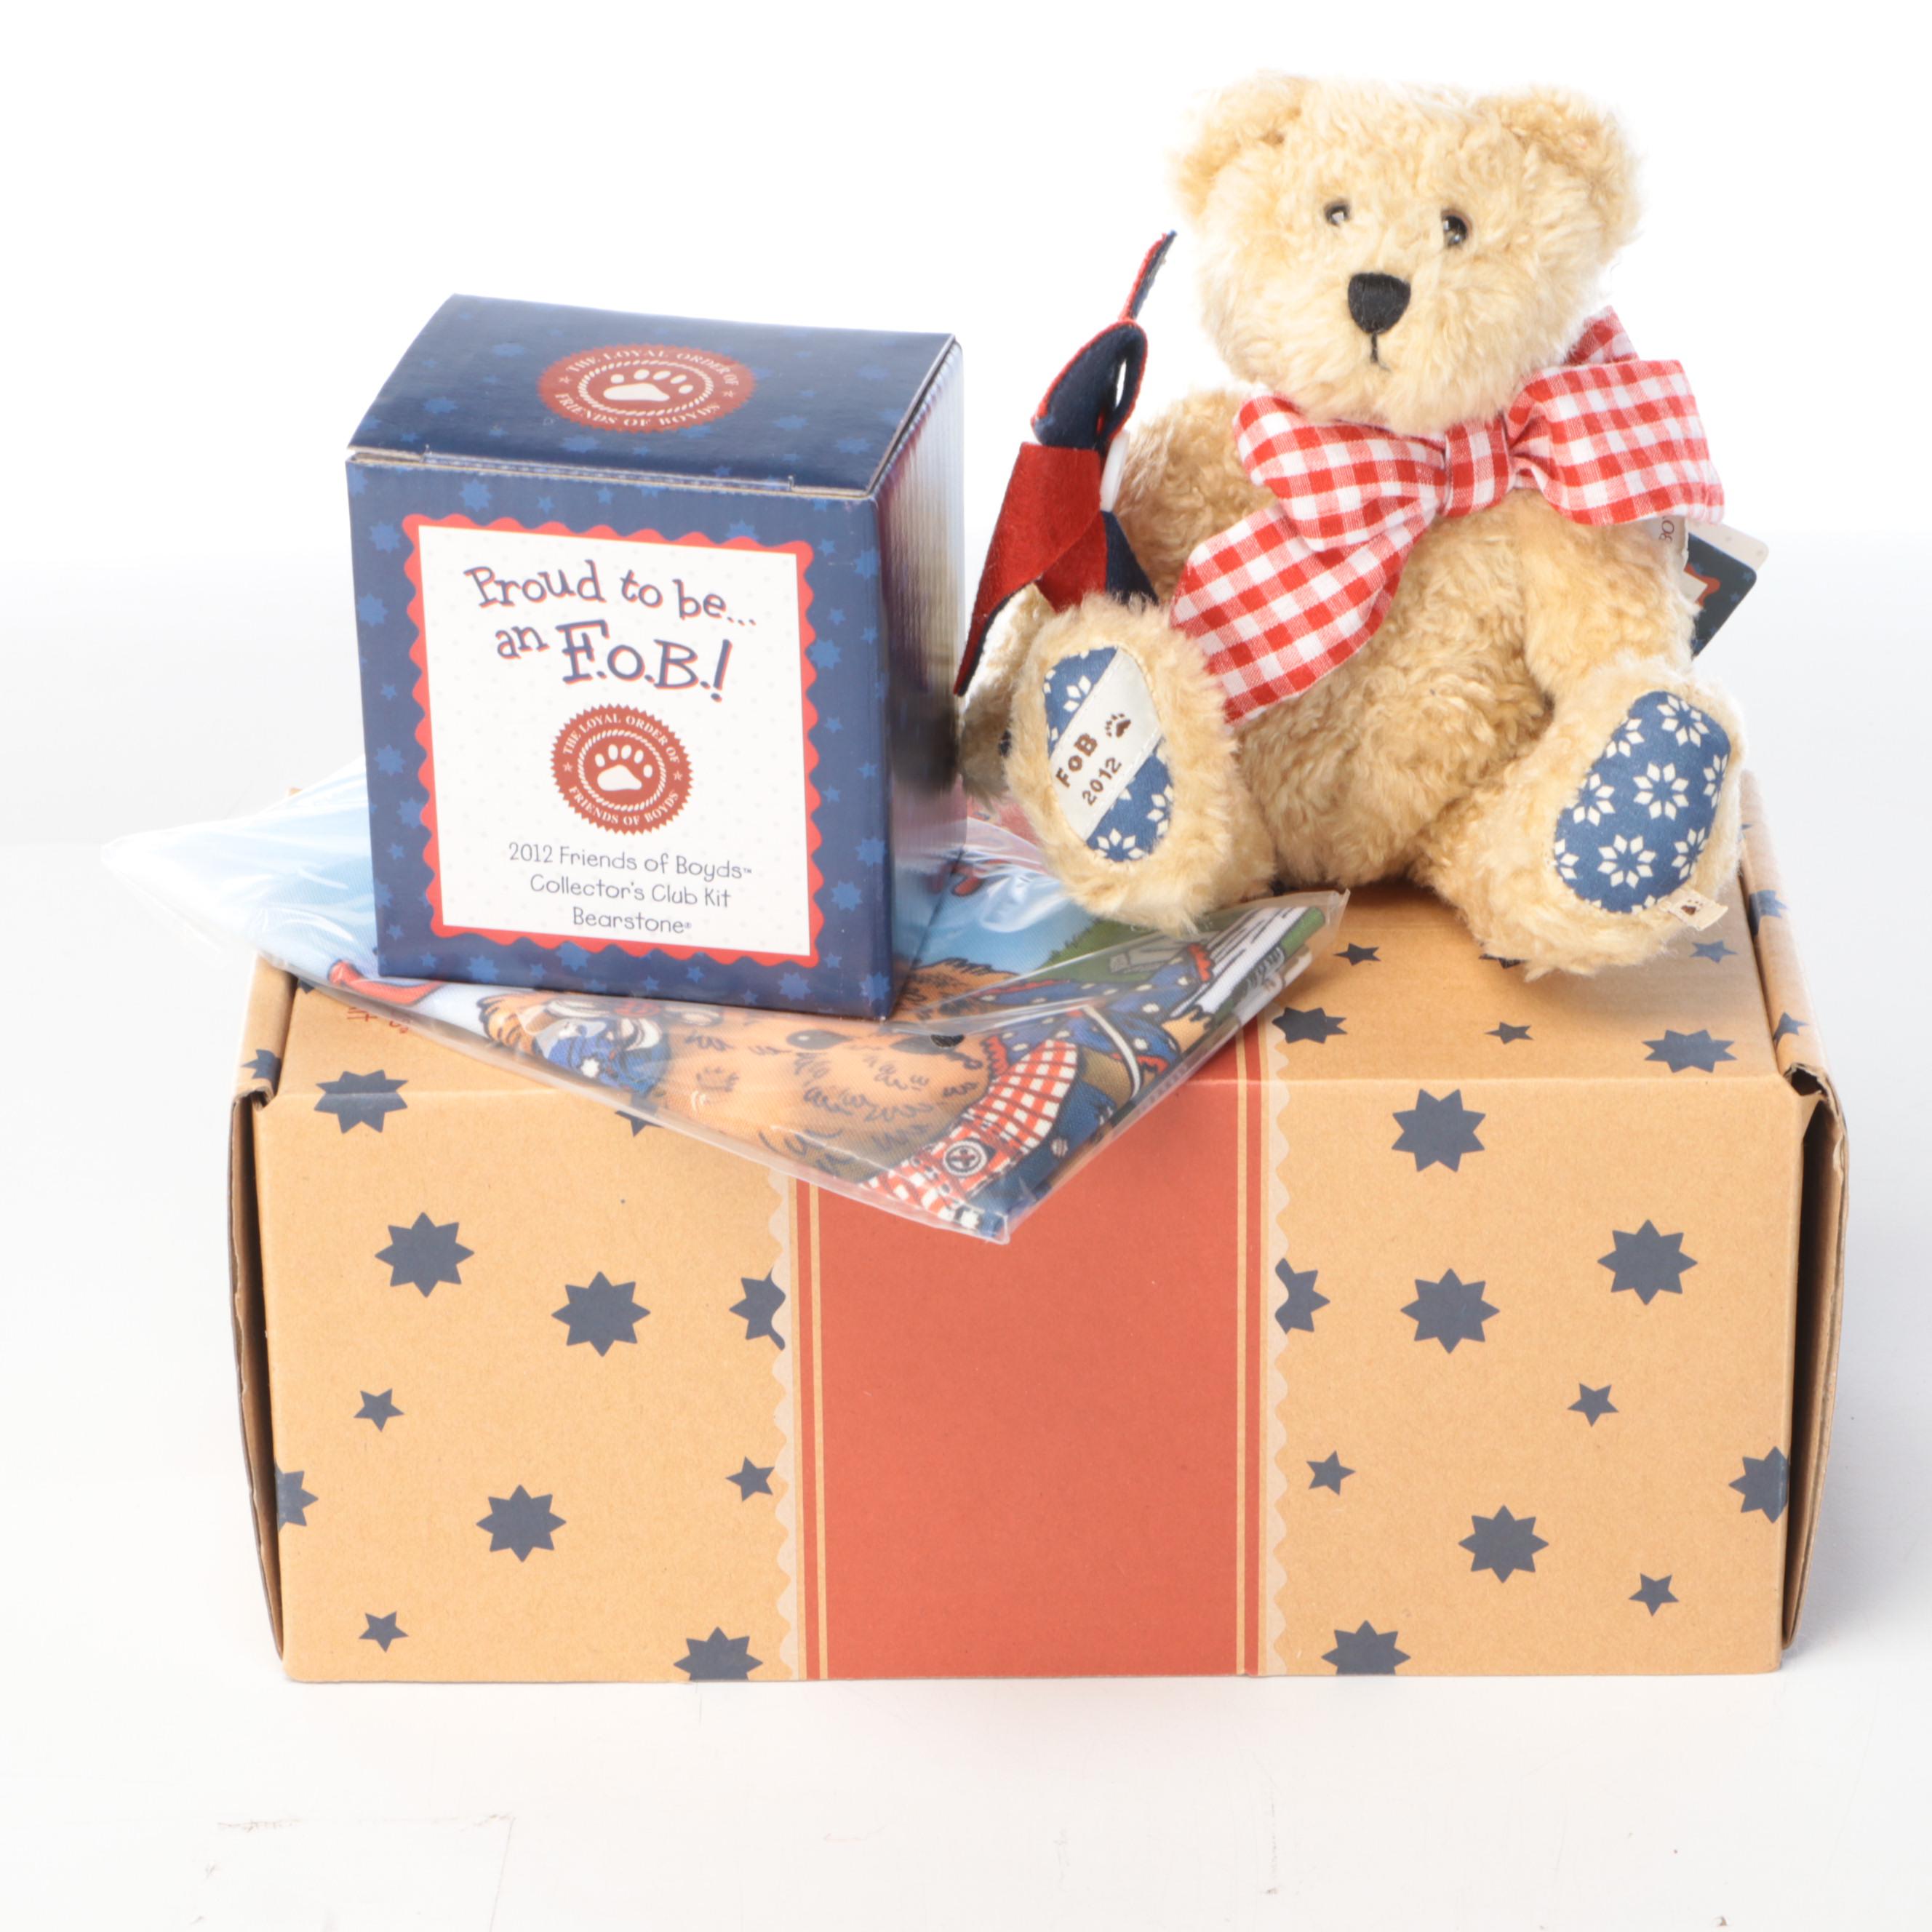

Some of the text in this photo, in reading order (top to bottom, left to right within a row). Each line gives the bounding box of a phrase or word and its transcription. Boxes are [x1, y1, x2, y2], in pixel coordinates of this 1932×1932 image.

[566, 356, 601, 372] THE
[604, 350, 668, 361] LOYAL
[677, 353, 731, 374] ORDER
[555, 393, 721, 426] FRIENDS OF BOYDS
[463, 559, 757, 626] Proud to be...
[495, 619, 733, 703] an F.O.B.!
[563, 714, 680, 764] THE LOYAL ORDER OF
[1082, 757, 1122, 806] 2012
[569, 786, 679, 826] FRIENDS OF BOYDS
[509, 842, 553, 863] 2012
[559, 846, 637, 870] Friends
[644, 853, 668, 874] of
[530, 874, 732, 908] Collector's Club Kit
